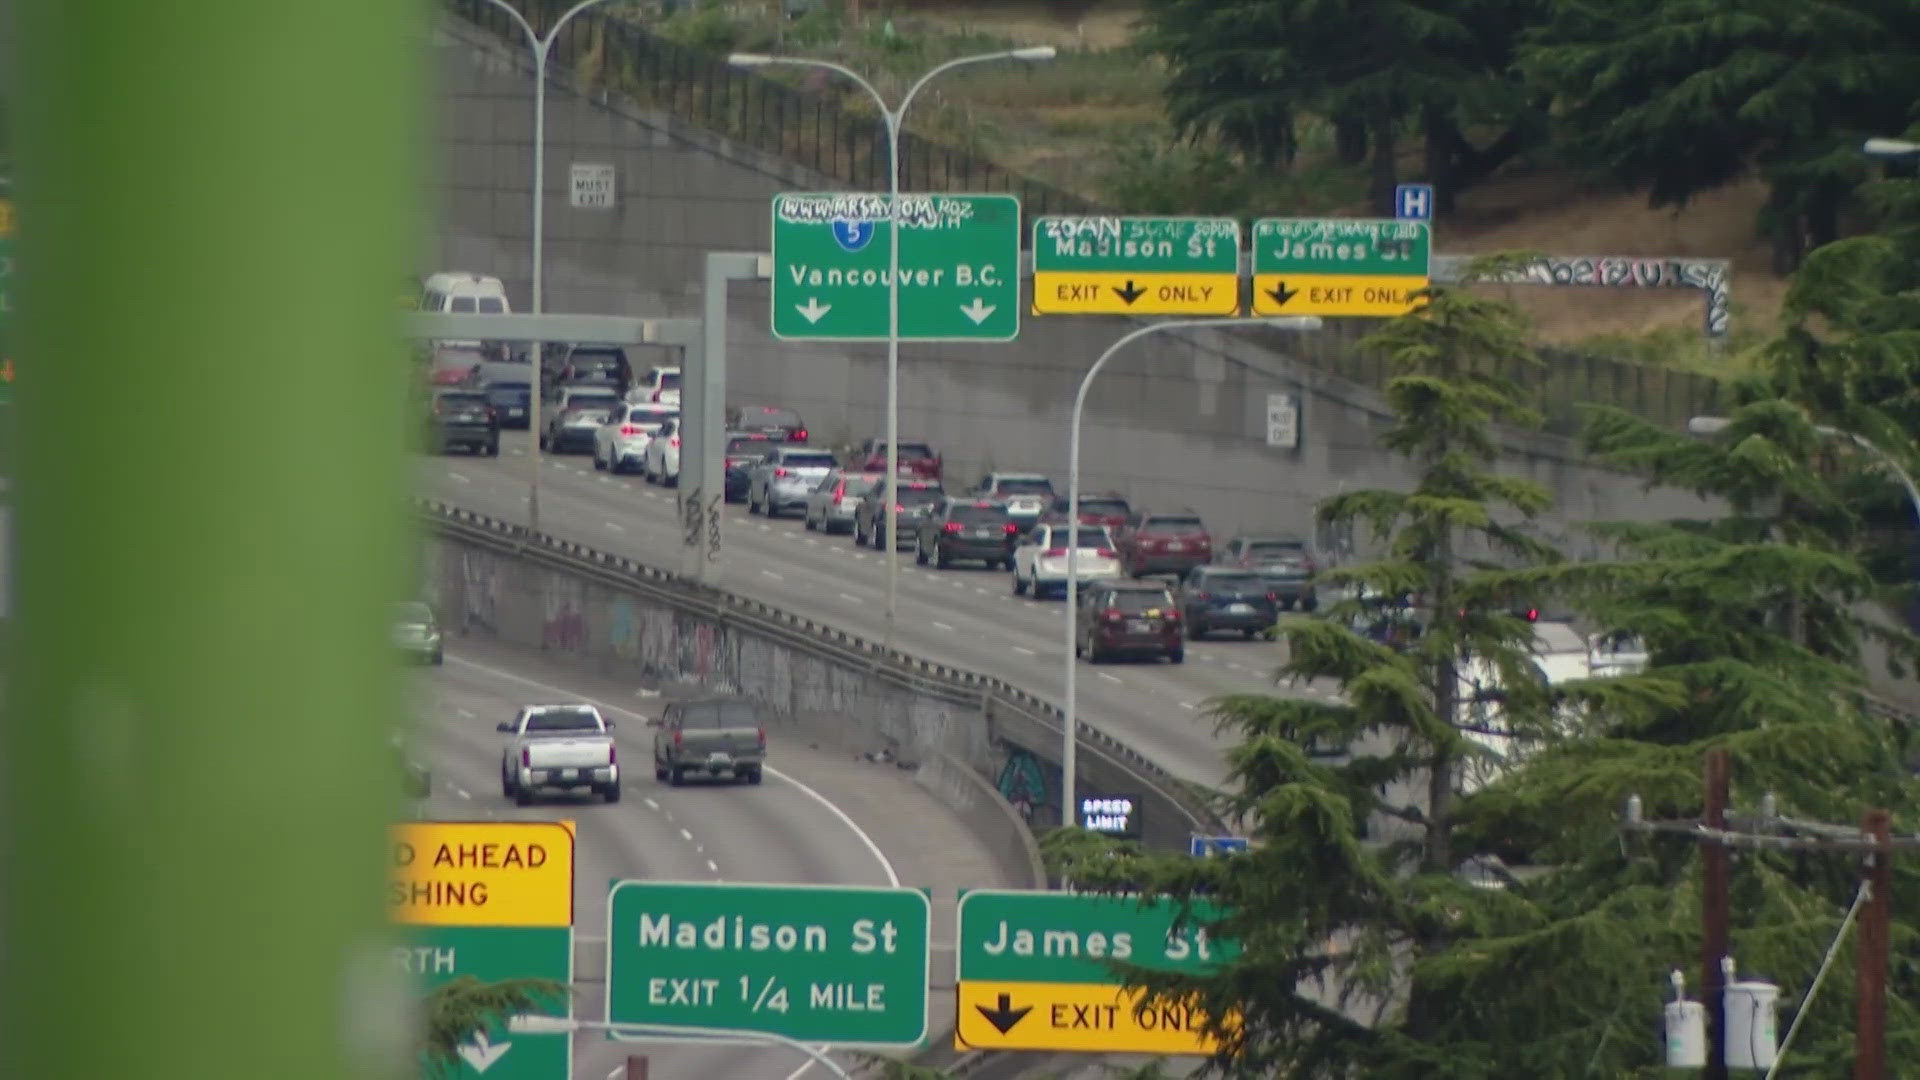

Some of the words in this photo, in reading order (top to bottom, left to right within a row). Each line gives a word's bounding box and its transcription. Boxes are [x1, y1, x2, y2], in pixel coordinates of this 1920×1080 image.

[577, 180, 609, 190] MUST
[580, 194, 606, 206] EXIT
[1404, 190, 1425, 216] H
[847, 219, 861, 243] 5
[1055, 237, 1173, 257] Madison
[1187, 236, 1216, 257] St
[1273, 238, 1367, 260] James
[790, 264, 944, 286] Vancouver
[955, 264, 1003, 287] B.C.
[1057, 285, 1100, 301] EXIT
[1158, 286, 1213, 302] ONLY
[1309, 287, 1353, 303] EXIT
[1083, 799, 1132, 814] SPEED
[1086, 815, 1128, 831] LIMIT
[433, 842, 548, 869] AHEAD
[639, 912, 827, 951] Madison
[851, 918, 898, 954] St
[983, 920, 1133, 958] James
[1164, 925, 1212, 961] St
[648, 978, 720, 1006] EXIT
[739, 974, 790, 1015] 1/4
[810, 983, 886, 1011] MILE
[1050, 1003, 1120, 1030] EXIT
[1138, 1004, 1205, 1032] ONL
